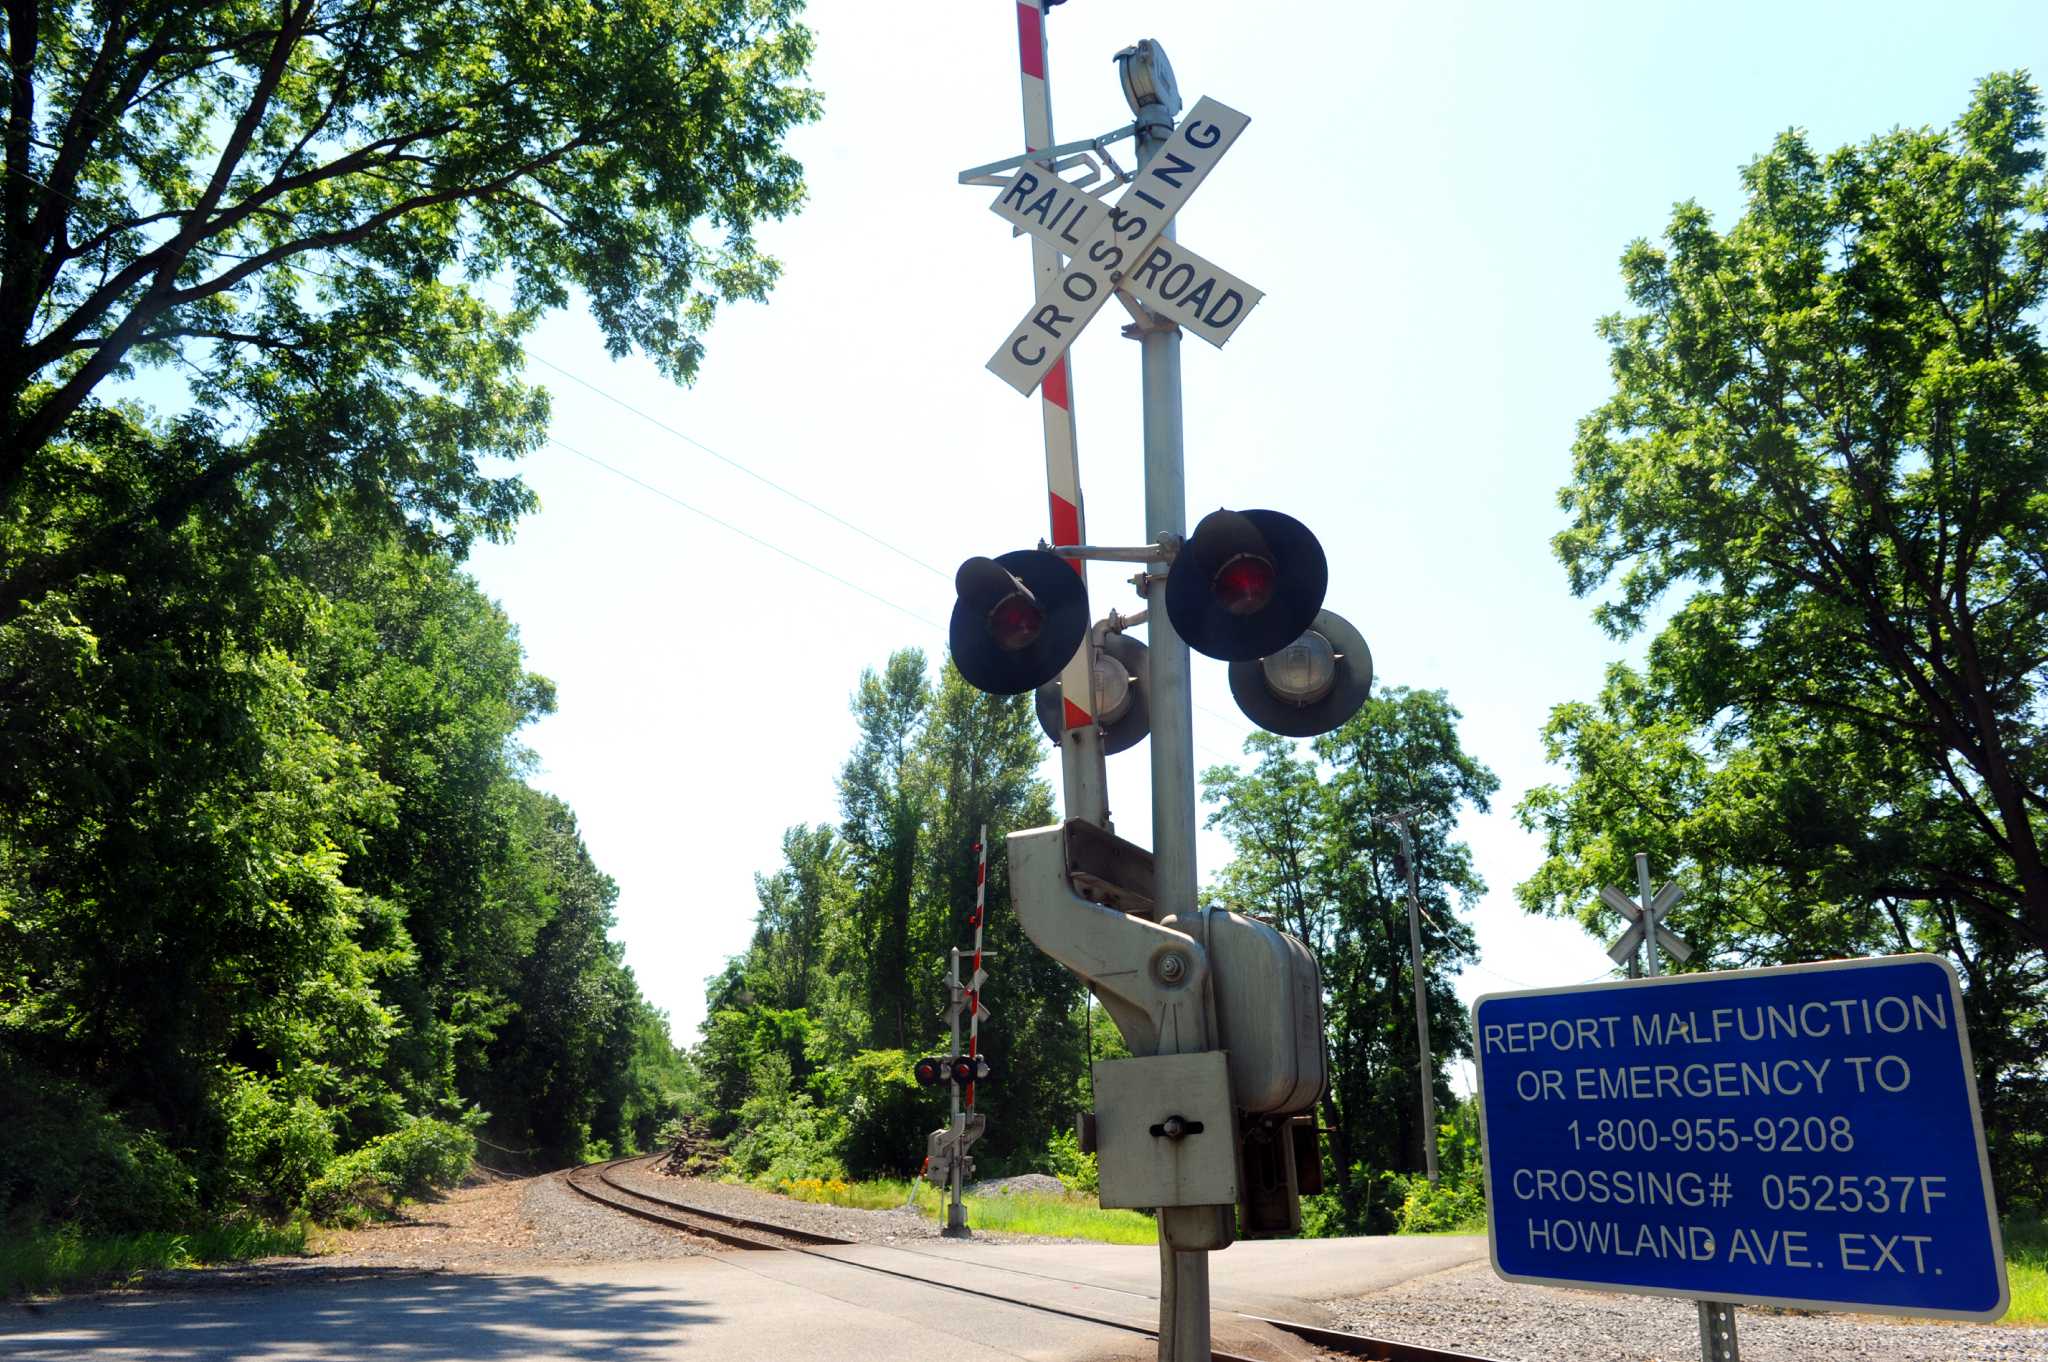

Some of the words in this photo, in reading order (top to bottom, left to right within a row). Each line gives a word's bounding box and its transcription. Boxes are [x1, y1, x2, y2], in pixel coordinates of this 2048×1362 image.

[1002, 172, 1088, 245] RAIL
[1132, 246, 1243, 328] ROAD
[1012, 120, 1221, 366] CROSSING
[1484, 1016, 1621, 1054] REPORT
[1633, 993, 1948, 1047] MALFUNCTION
[1516, 1070, 1566, 1101] OR
[1577, 1059, 1831, 1101] EMERGENCY
[1844, 1054, 1911, 1094] TO
[1567, 1116, 1854, 1152] 1-800-955-9208
[1512, 1168, 1733, 1208] CROSSING#
[1761, 1175, 1947, 1215] 052537F
[1528, 1218, 1716, 1262] HOWLAND
[1728, 1228, 1824, 1269] AVE.
[1839, 1233, 1944, 1276] EXT.
